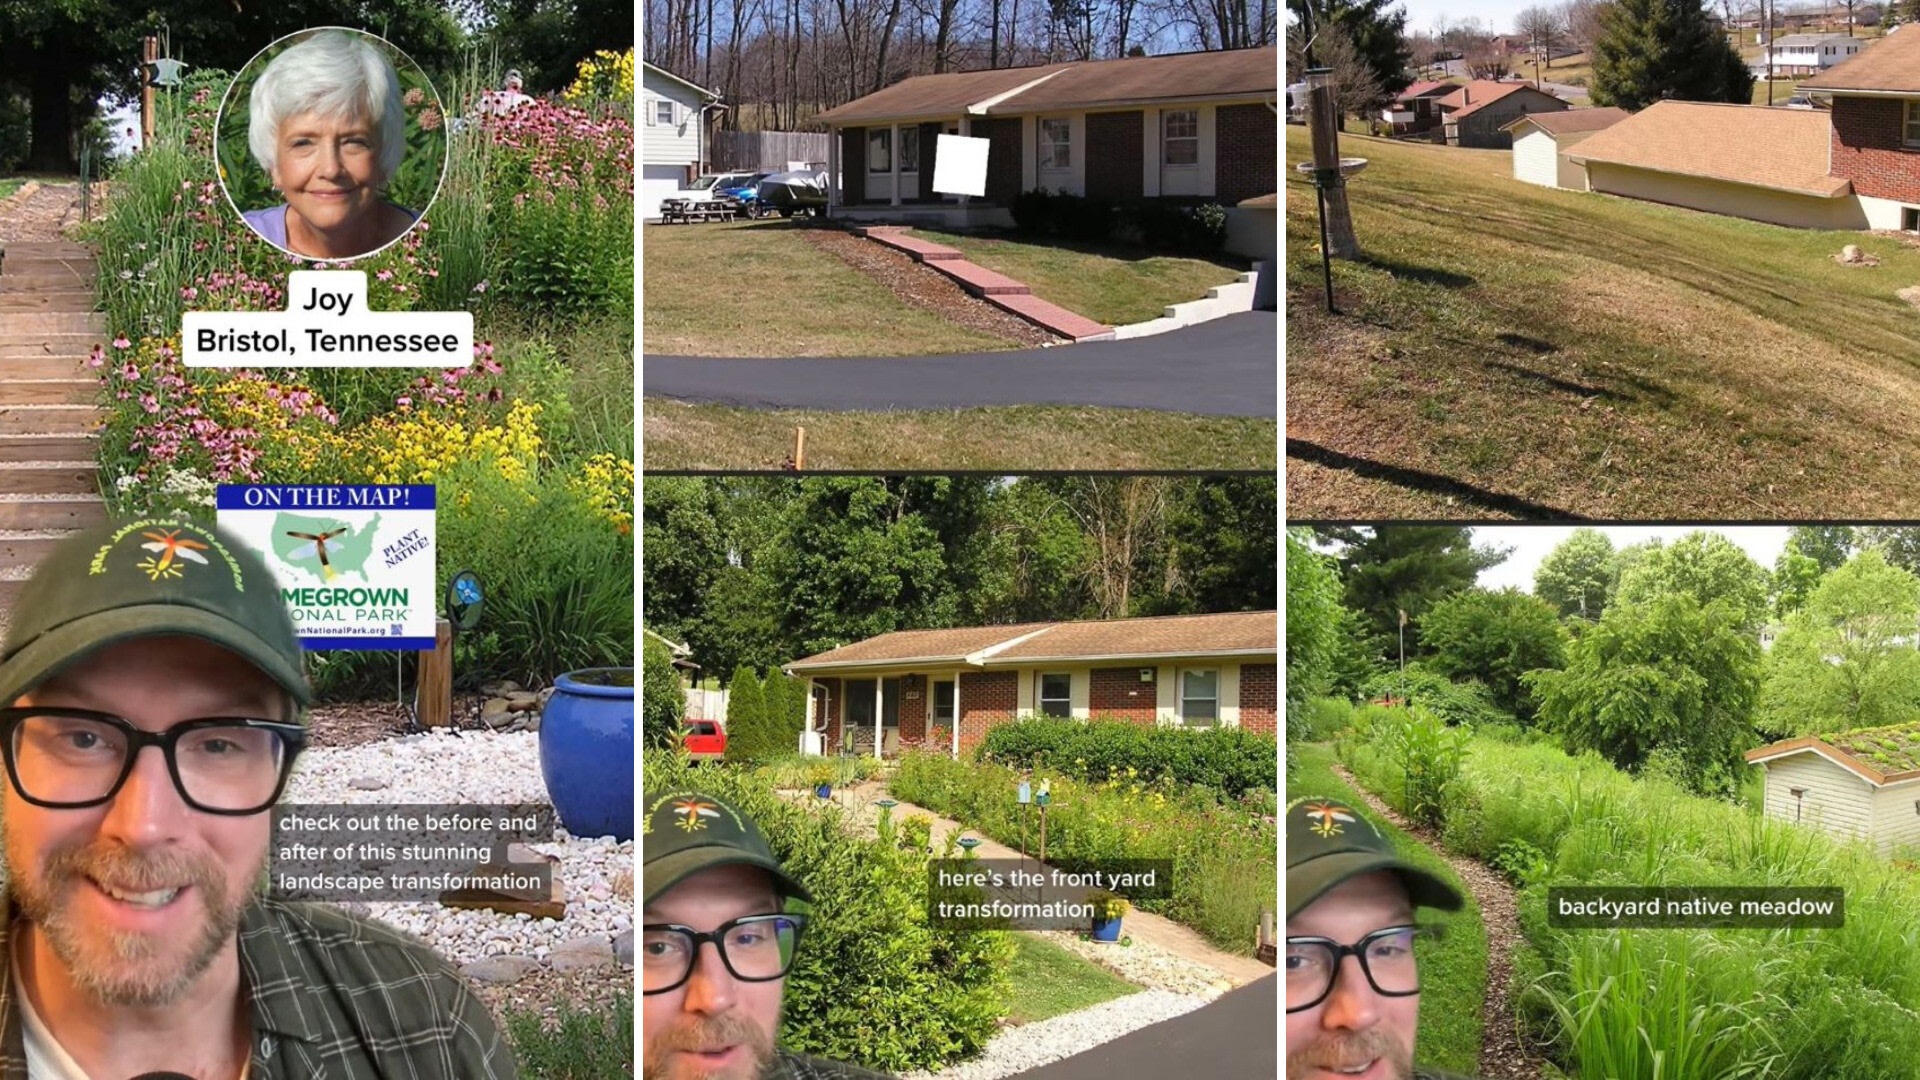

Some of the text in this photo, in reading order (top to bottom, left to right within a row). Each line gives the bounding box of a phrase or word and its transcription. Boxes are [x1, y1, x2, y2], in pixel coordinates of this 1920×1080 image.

[244, 487, 410, 506] ON THE MAP!
[383, 528, 419, 557] PLANT
[385, 536, 430, 569] NATIVE!
[280, 587, 409, 607] MEGROWN
[291, 608, 408, 621] ONAL PARK
[294, 625, 386, 636] wnNationalPark.org
